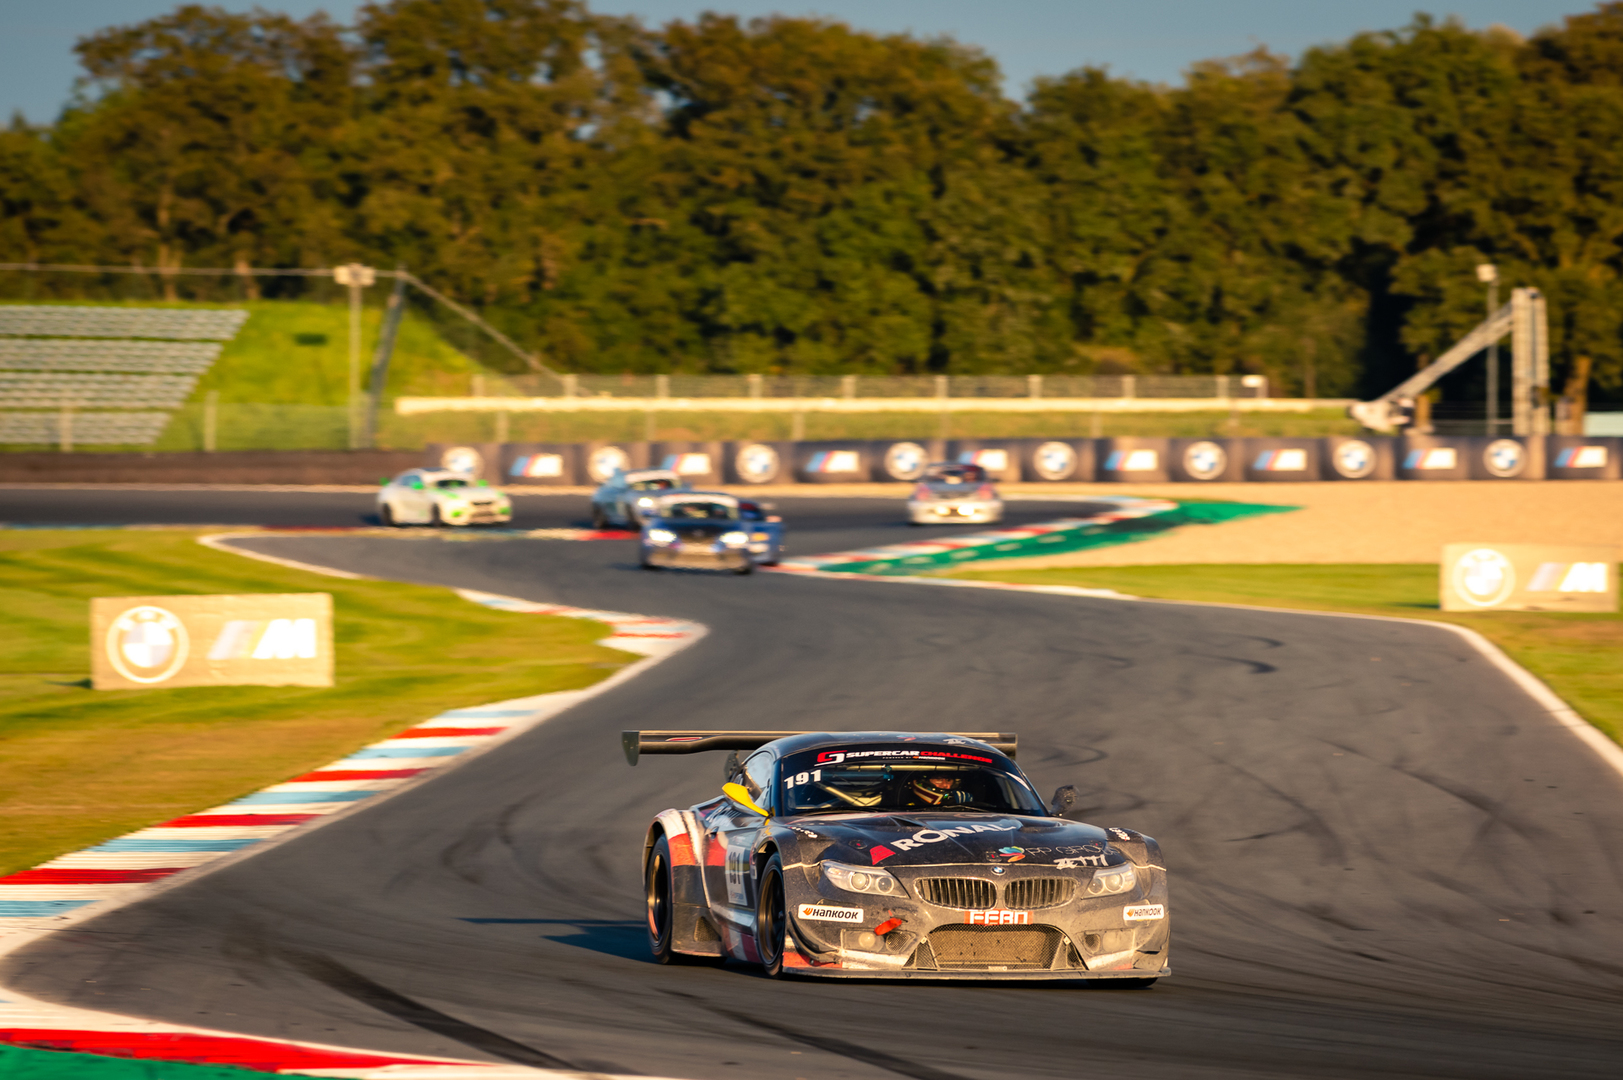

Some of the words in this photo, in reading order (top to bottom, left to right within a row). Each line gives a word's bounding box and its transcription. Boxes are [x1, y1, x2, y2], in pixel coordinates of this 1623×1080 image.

[846, 750, 920, 759] SUPERCAR
[920, 750, 993, 764] CHALLENGE
[783, 769, 822, 790] 191
[890, 823, 1017, 851] RONAL
[1053, 853, 1109, 870] ZETTI
